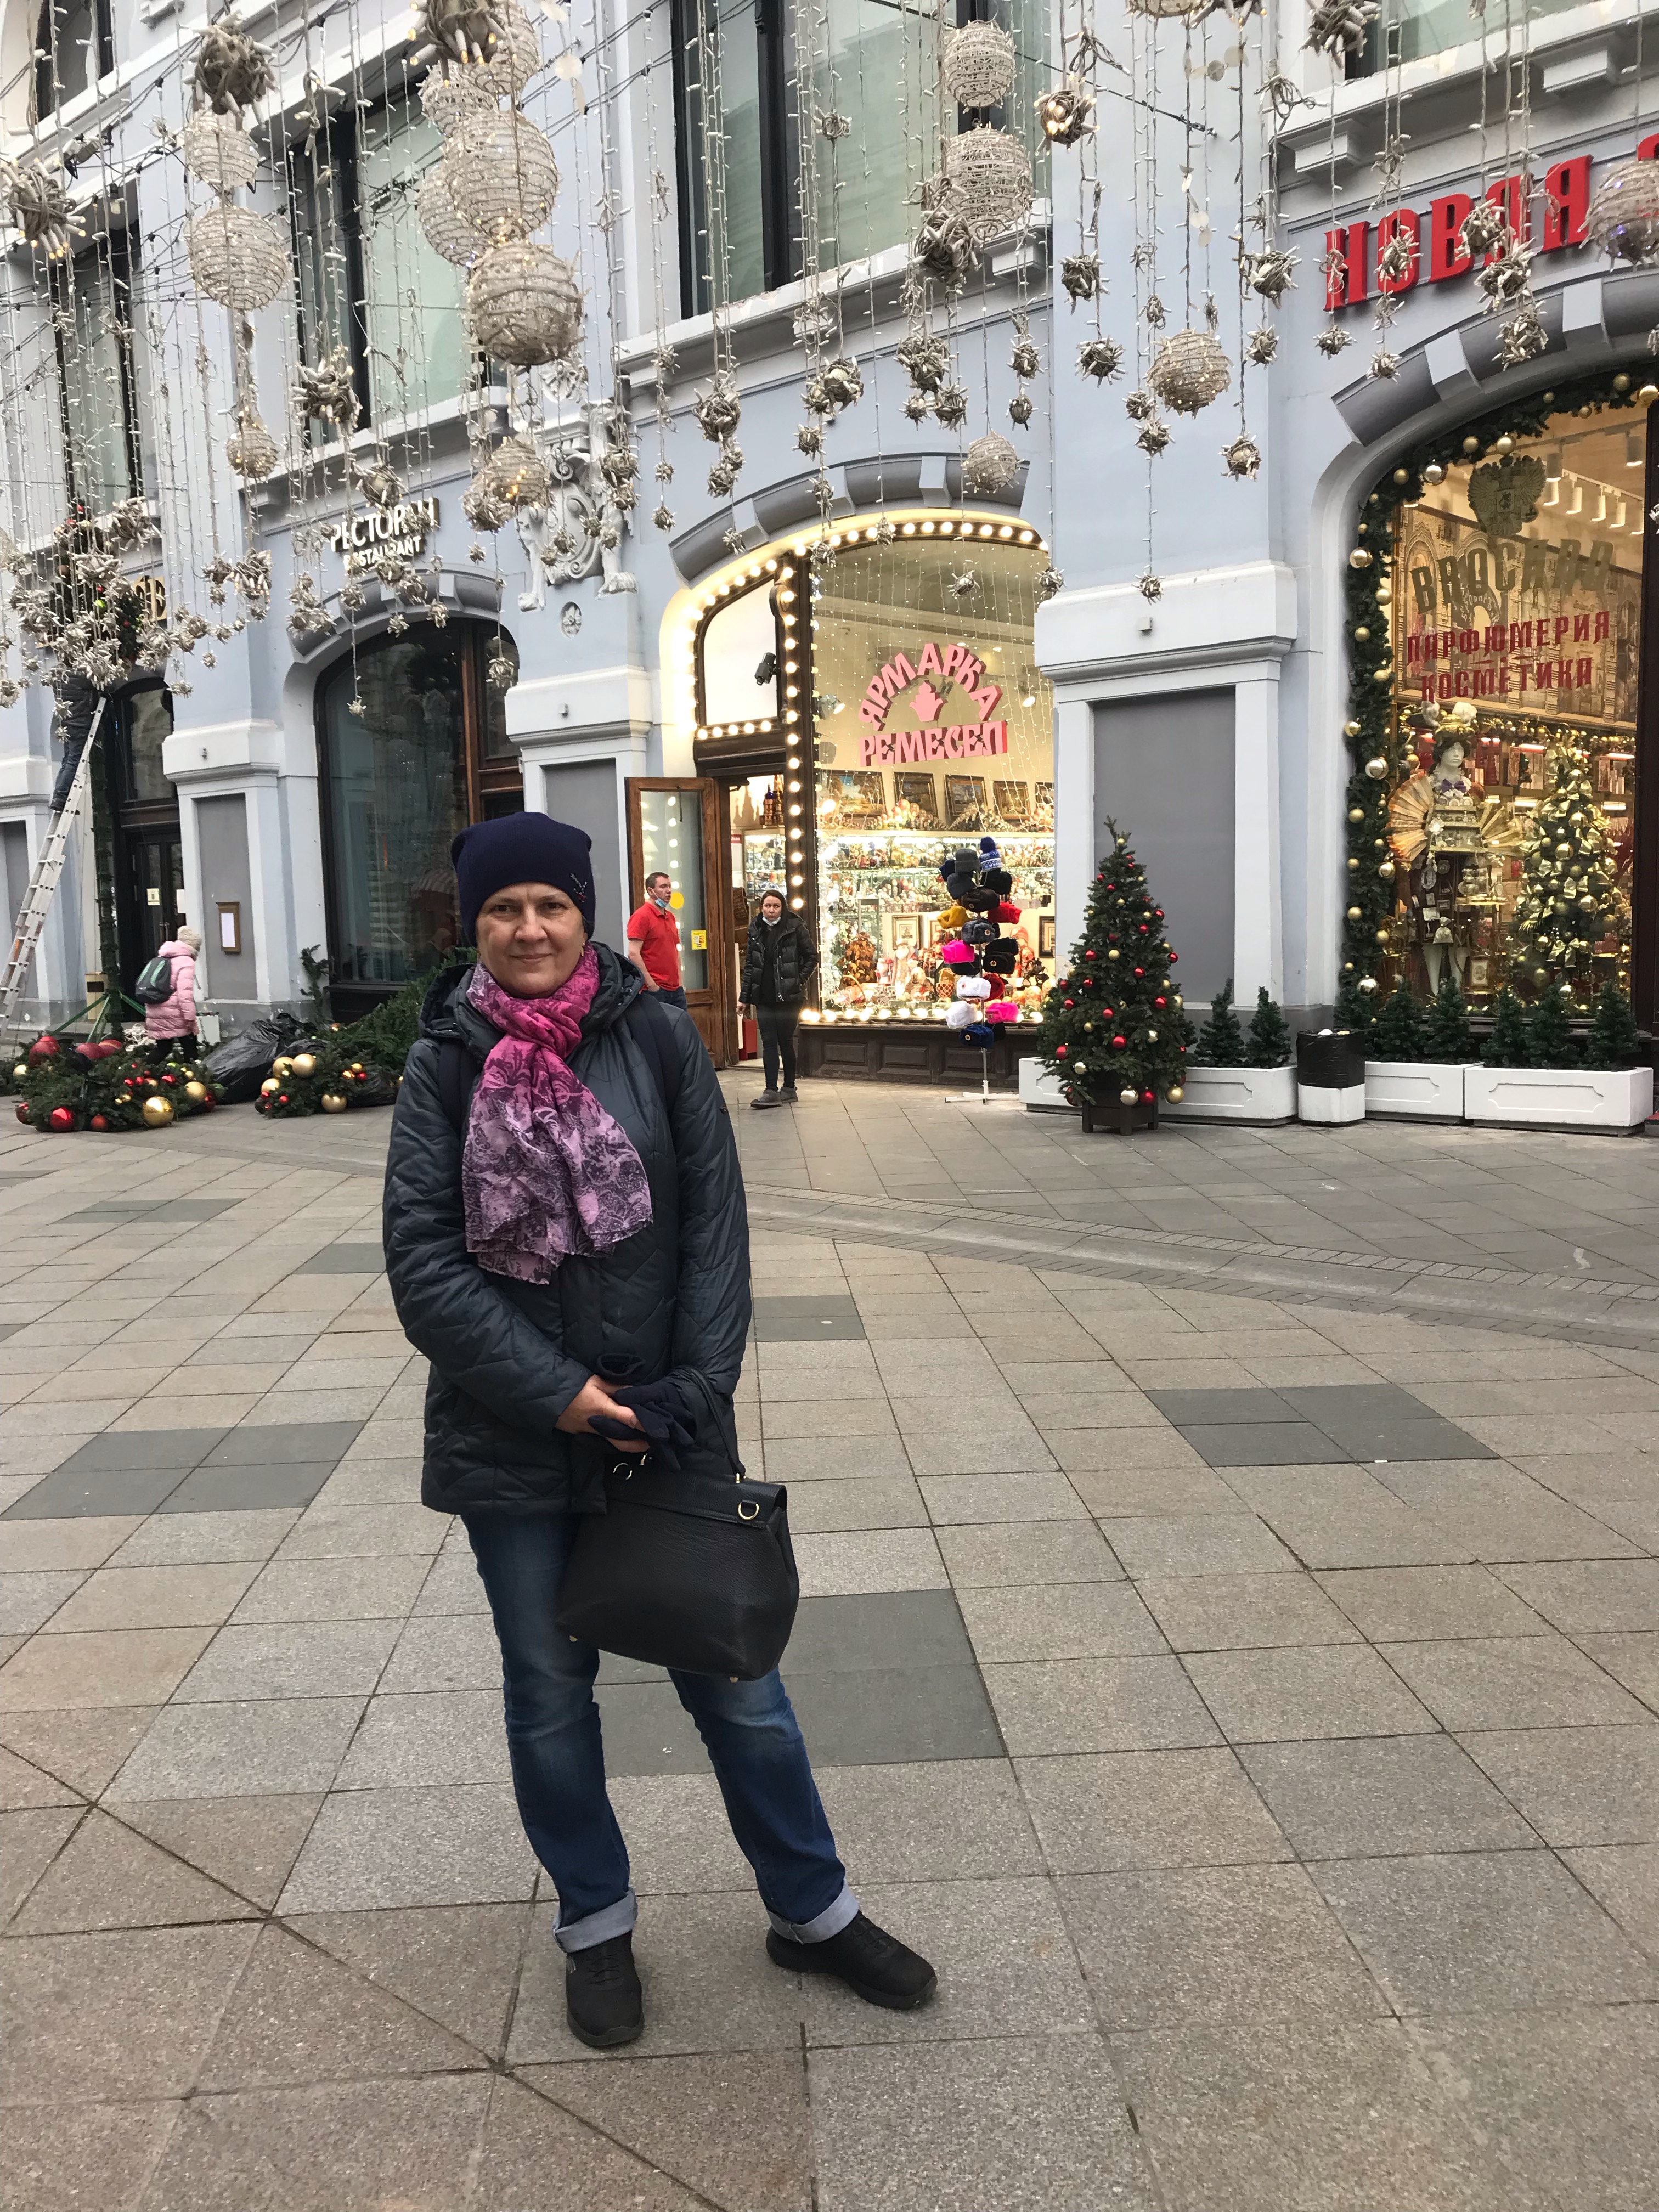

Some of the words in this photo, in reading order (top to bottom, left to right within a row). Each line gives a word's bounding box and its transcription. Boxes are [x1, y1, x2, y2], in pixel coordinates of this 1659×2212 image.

[1323, 154, 1593, 312] НОВАЯ
[343, 535, 421, 572] RSTAUANT
[1410, 539, 1614, 614] BROCARD
[1407, 611, 1610, 667] ПАРФЮМЕРИЯ
[858, 642, 1003, 732] ЯРМАРКА
[1421, 657, 1593, 704] КОСМЕТИКА
[860, 720, 1008, 767] РЕМЕСЕЛ
